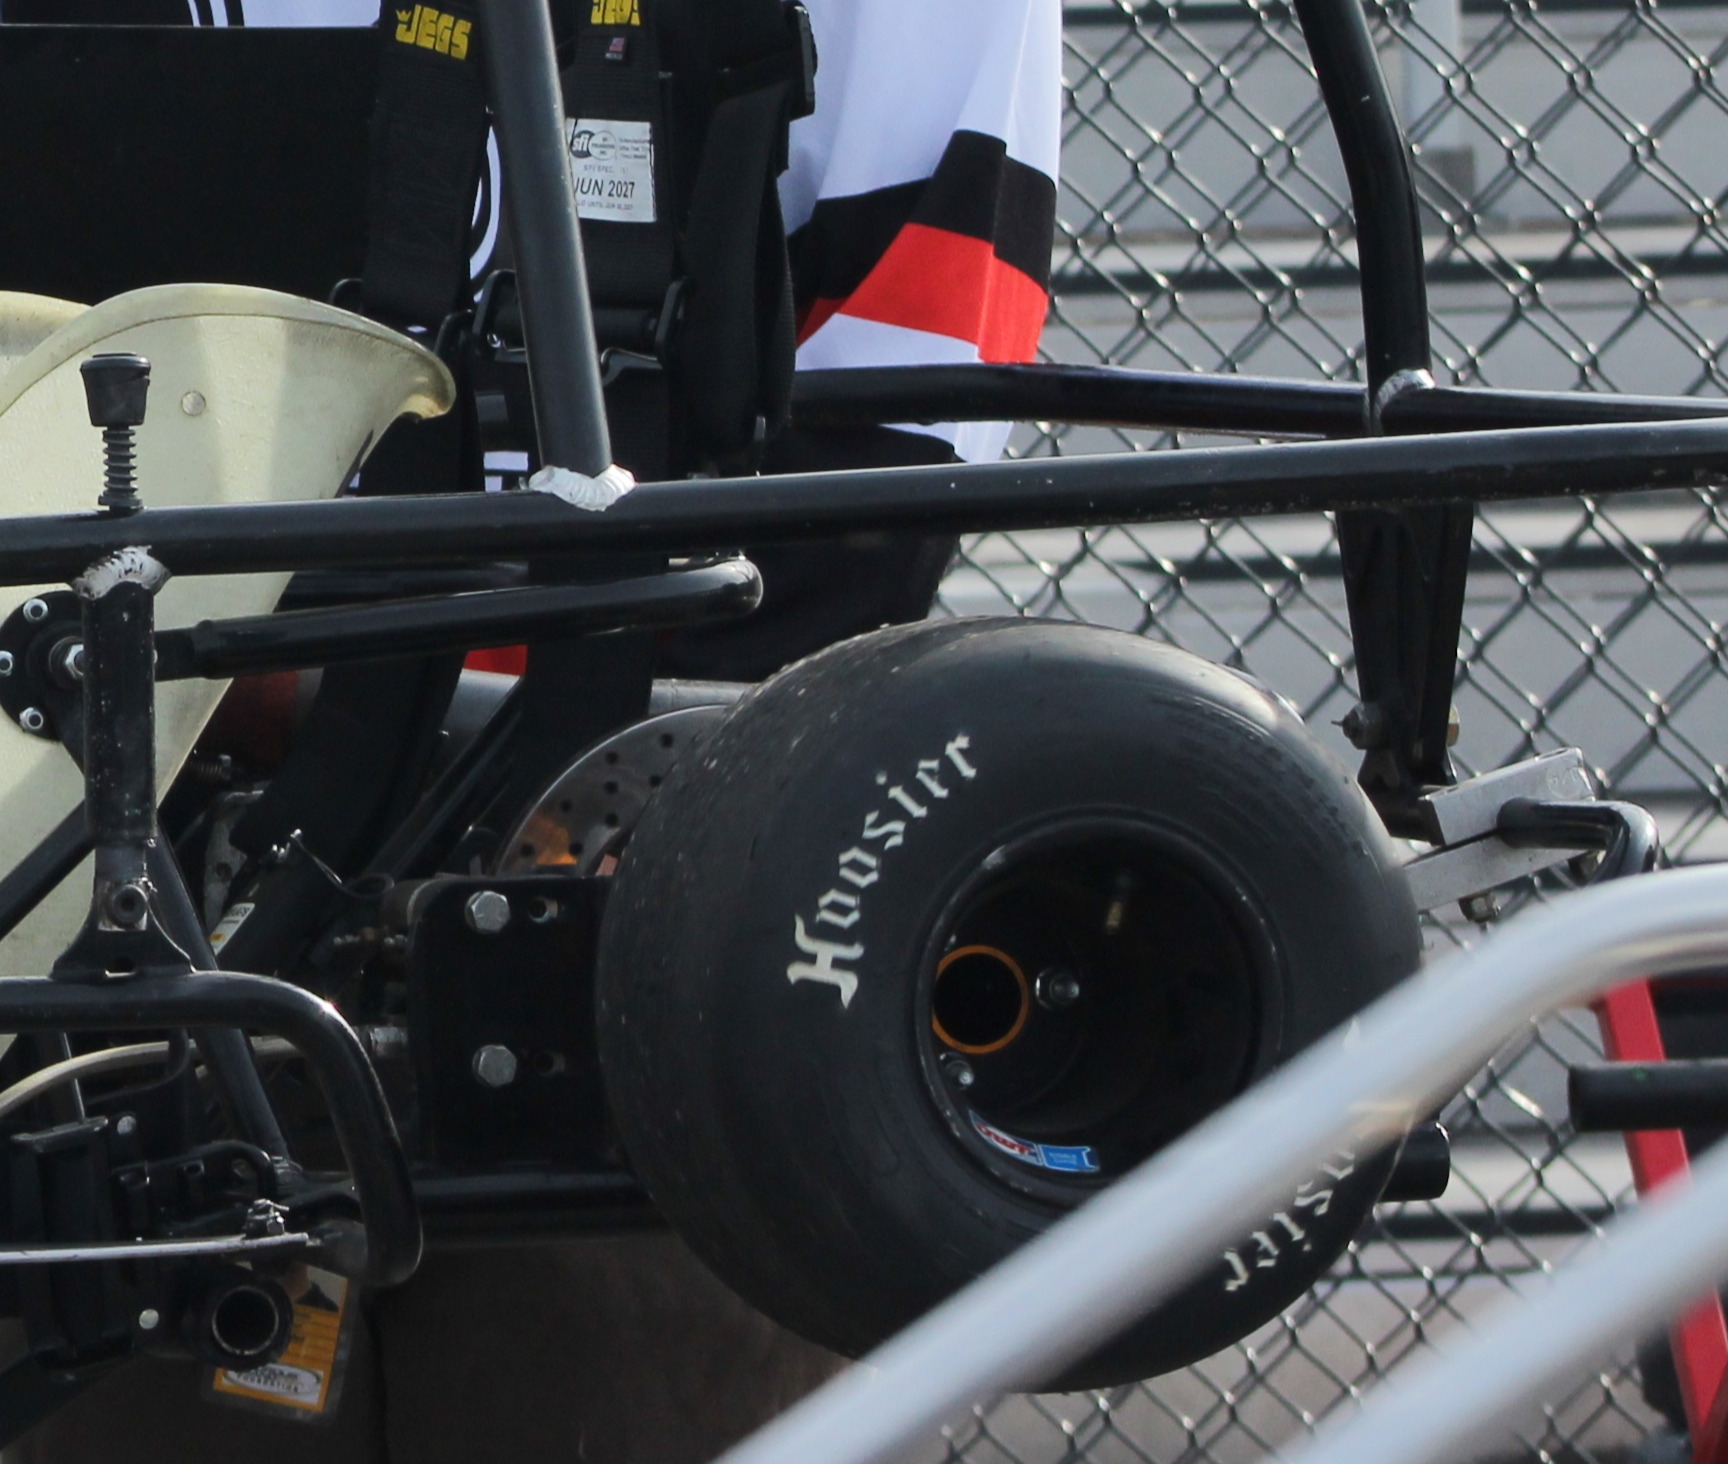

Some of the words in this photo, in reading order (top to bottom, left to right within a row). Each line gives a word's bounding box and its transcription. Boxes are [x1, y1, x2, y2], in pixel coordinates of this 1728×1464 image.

[395, 4, 472, 60] JEGS
[575, 177, 603, 196] JUN
[608, 180, 635, 198] 2027
[786, 732, 977, 1009] Hoosier
